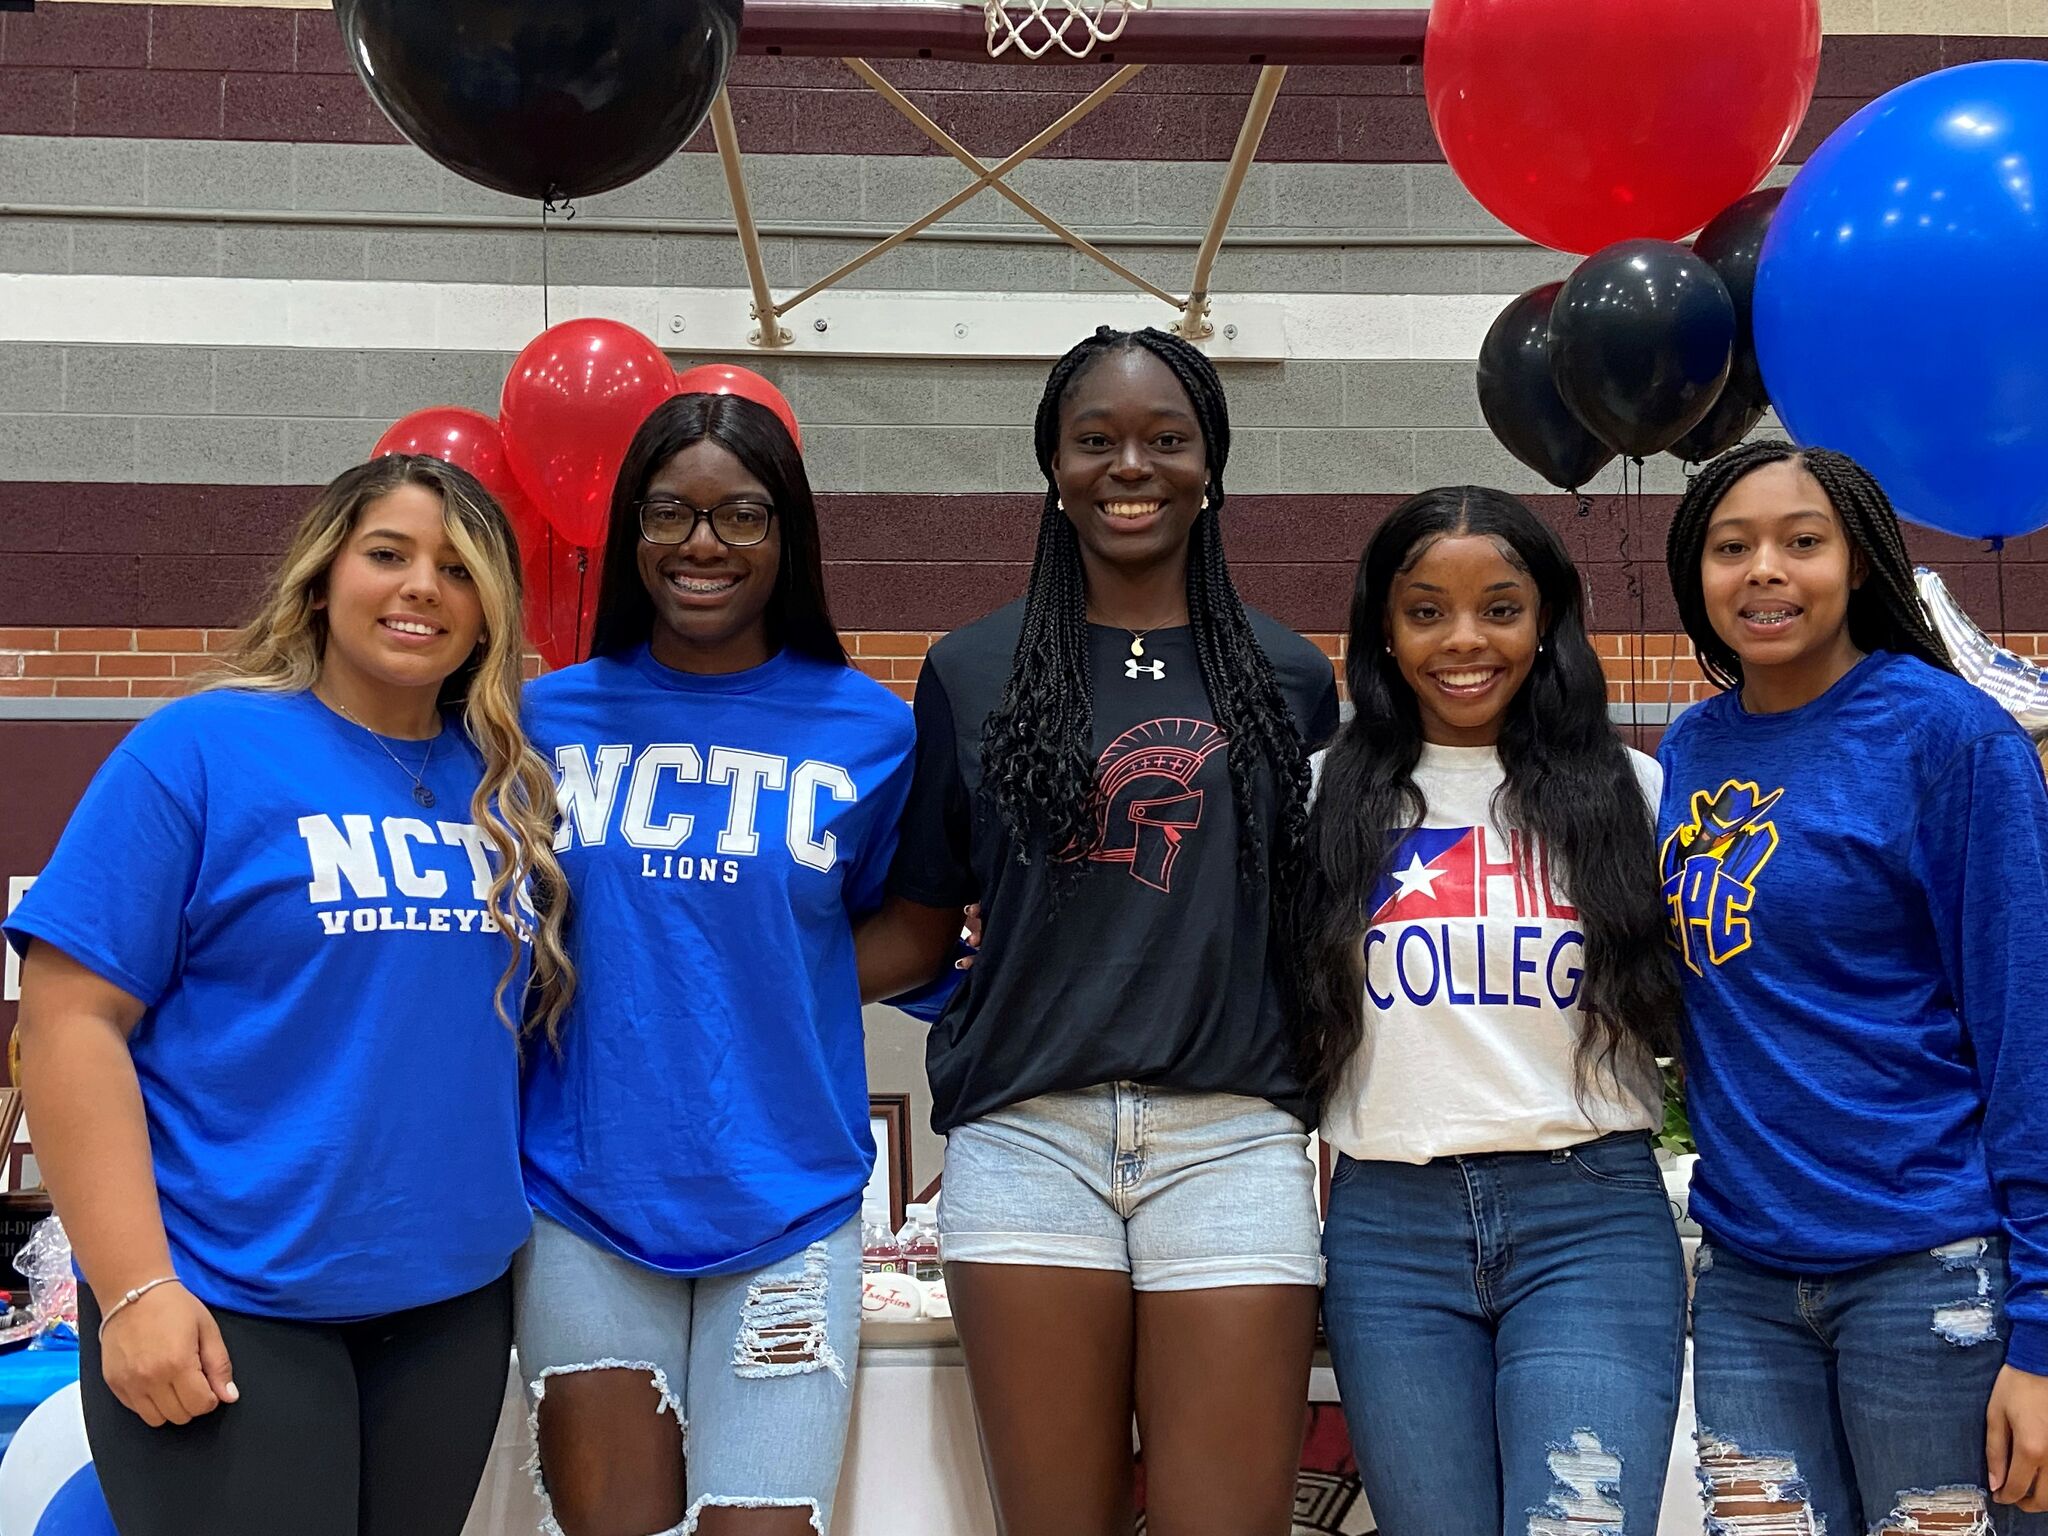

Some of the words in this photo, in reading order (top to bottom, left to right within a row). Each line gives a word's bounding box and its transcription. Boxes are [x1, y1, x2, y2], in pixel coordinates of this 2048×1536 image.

[554, 743, 857, 873] NCTC
[641, 853, 739, 884] LIONS
[1363, 923, 1598, 1011] COLLEG
